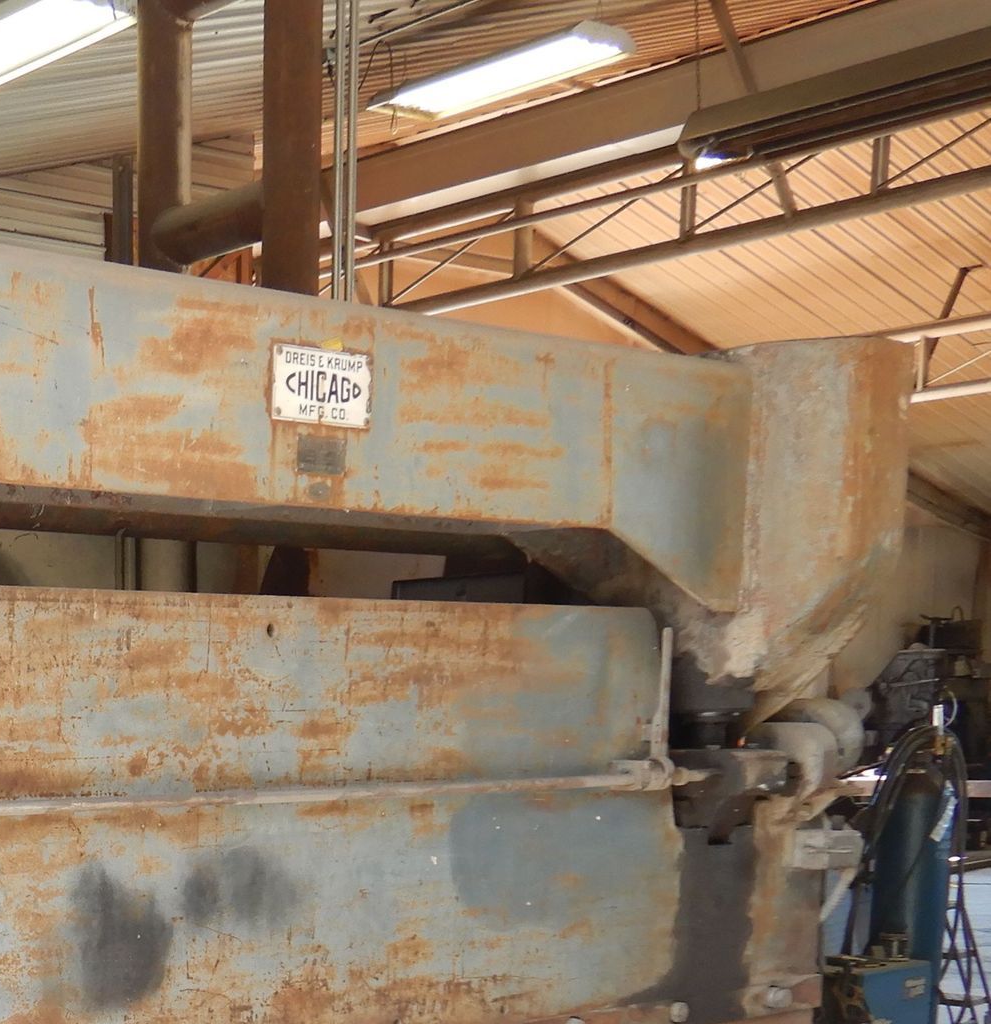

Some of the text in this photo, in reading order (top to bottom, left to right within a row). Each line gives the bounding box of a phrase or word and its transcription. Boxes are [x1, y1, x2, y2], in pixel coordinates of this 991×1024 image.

[285, 351, 315, 366] DREIS
[327, 357, 362, 372] KRUMP
[286, 370, 361, 403] CHICAGO
[331, 407, 349, 421] CO.
